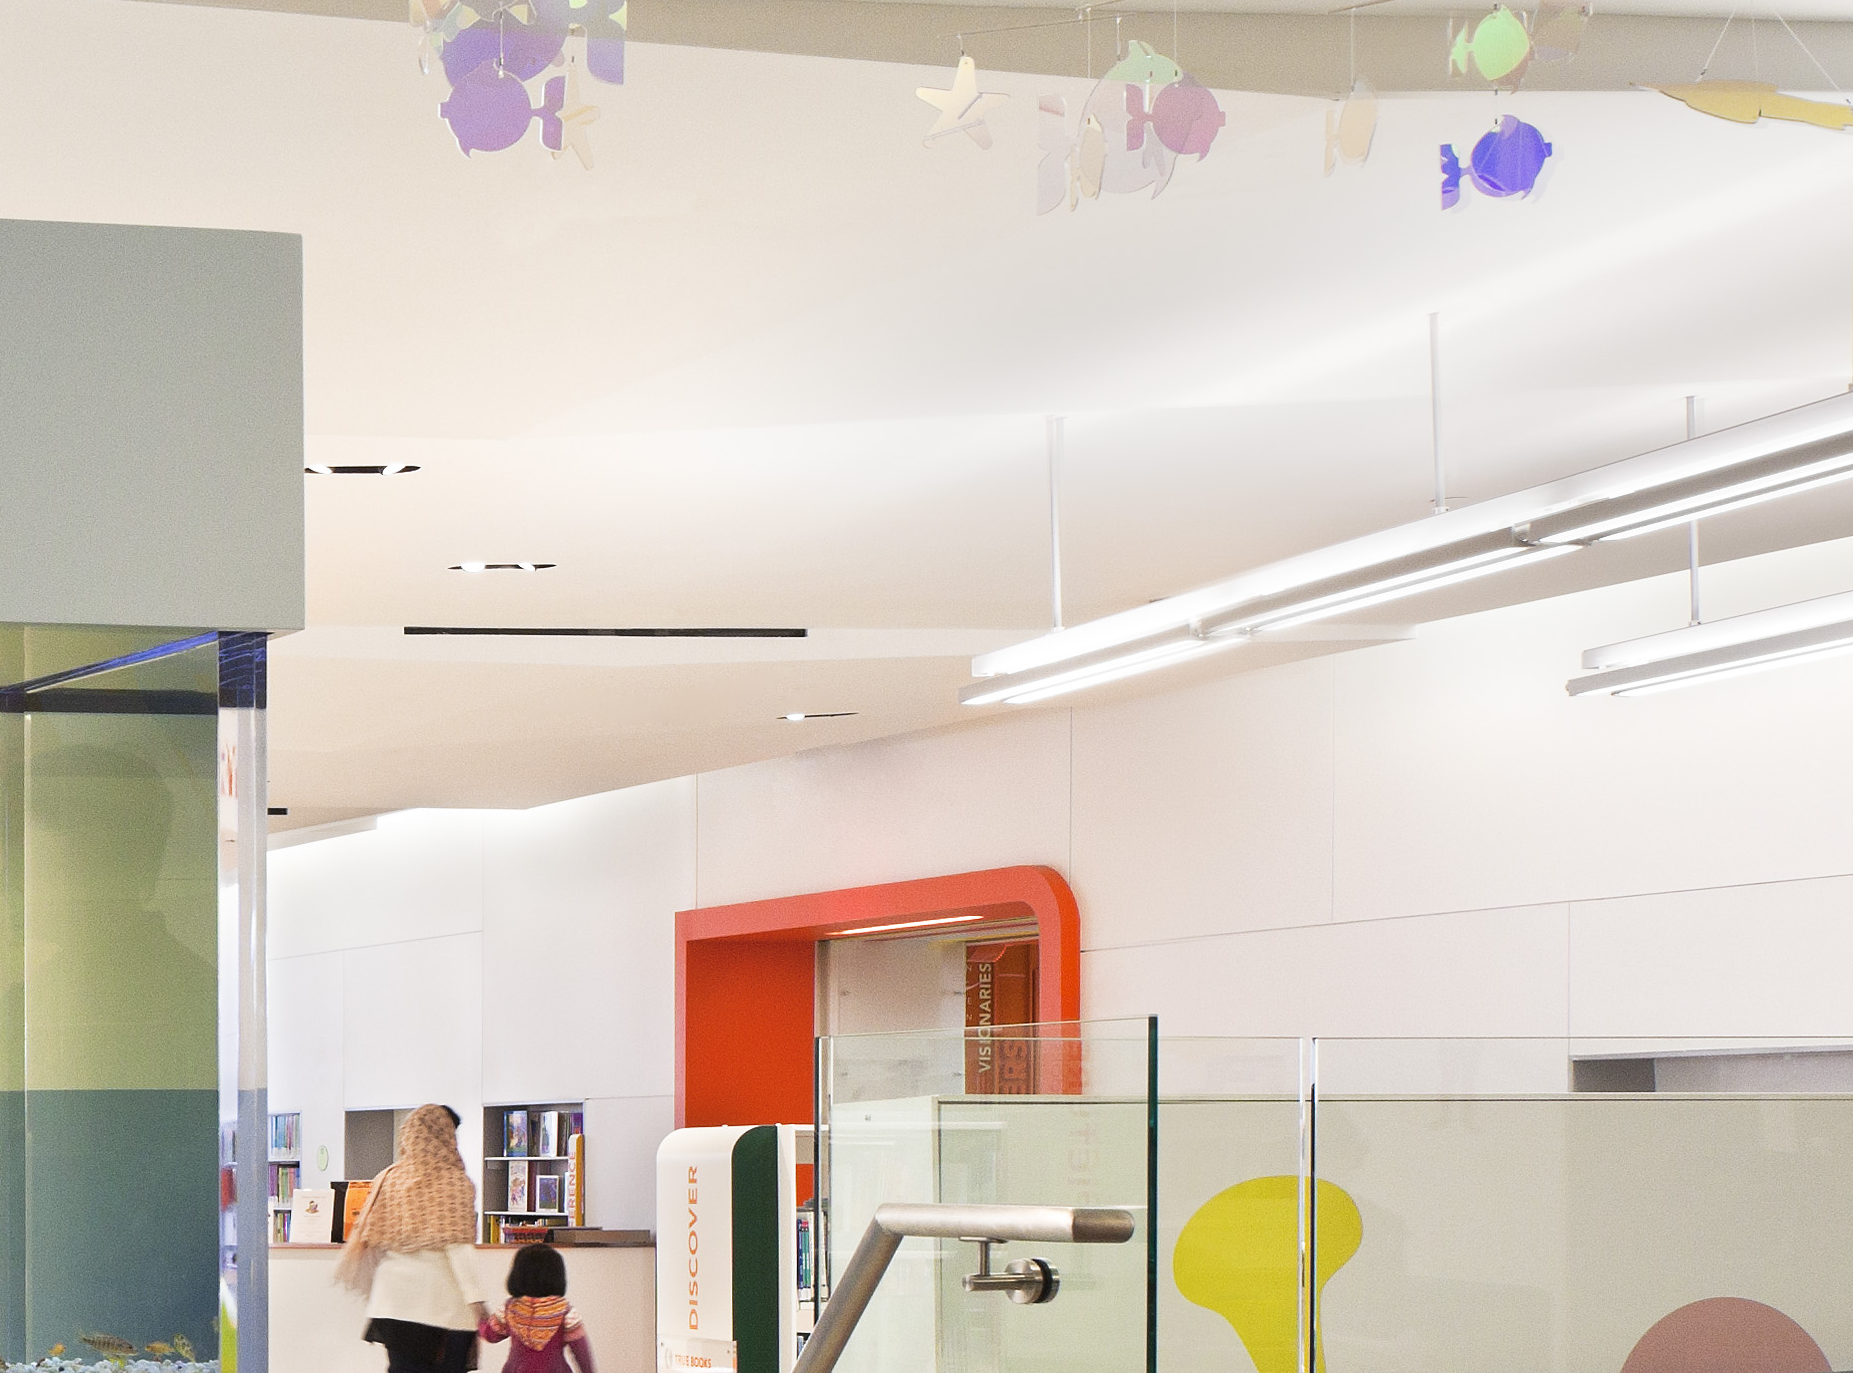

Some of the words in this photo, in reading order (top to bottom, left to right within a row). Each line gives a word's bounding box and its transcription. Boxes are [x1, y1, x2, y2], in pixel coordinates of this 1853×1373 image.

[978, 963, 991, 1073] VISIONARIES
[688, 1166, 698, 1330] DISCOVER
[674, 1354, 689, 1367] TRUE
[690, 1356, 712, 1369] BOOKS
